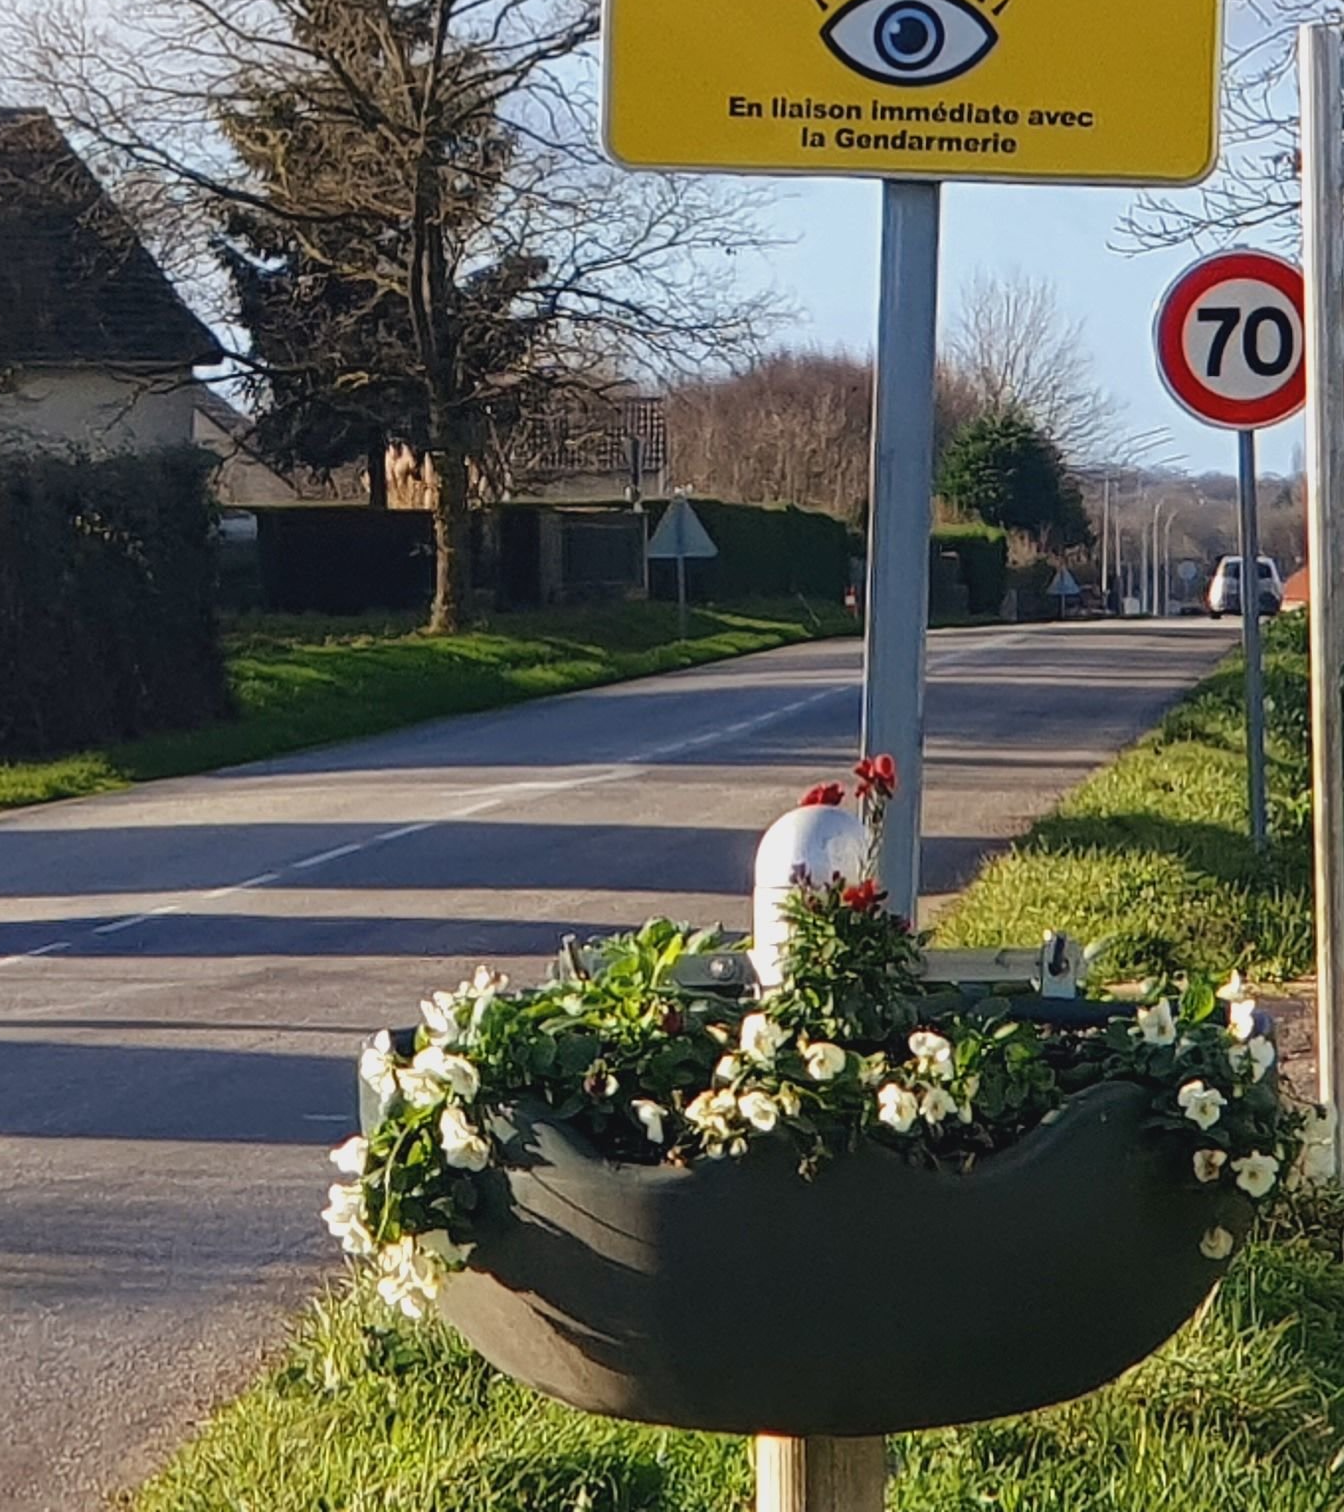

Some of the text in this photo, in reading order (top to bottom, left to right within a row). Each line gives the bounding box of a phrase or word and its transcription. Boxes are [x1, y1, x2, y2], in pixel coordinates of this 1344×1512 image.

[729, 96, 1094, 127] En liaison immédiate avec
[802, 127, 1017, 153] la Gendarmerie
[1197, 306, 1294, 377] 70
